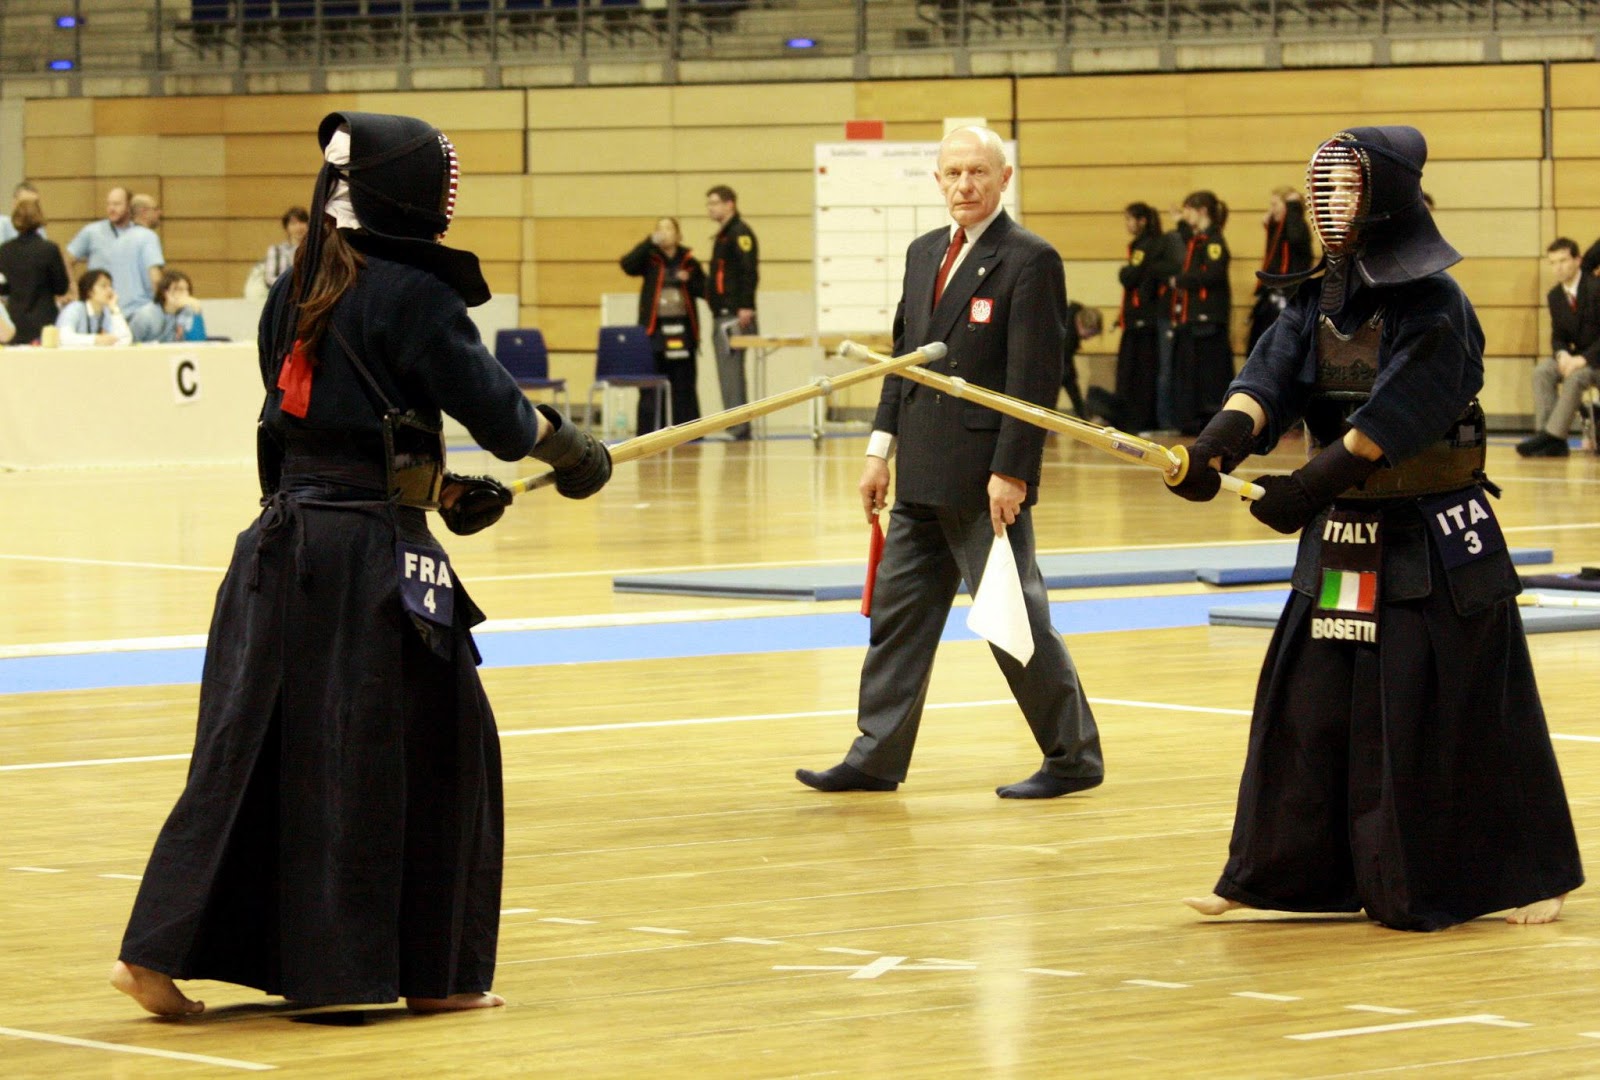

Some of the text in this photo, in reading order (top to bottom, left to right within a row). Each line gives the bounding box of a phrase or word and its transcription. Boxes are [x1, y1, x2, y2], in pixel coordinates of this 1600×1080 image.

[177, 360, 198, 397] C
[1436, 498, 1489, 536] ITA
[1322, 519, 1379, 544] ITALY
[1463, 530, 1483, 555] 3
[404, 551, 453, 588] FRA
[423, 587, 437, 614] 4
[1311, 617, 1377, 643] BOSETTI
